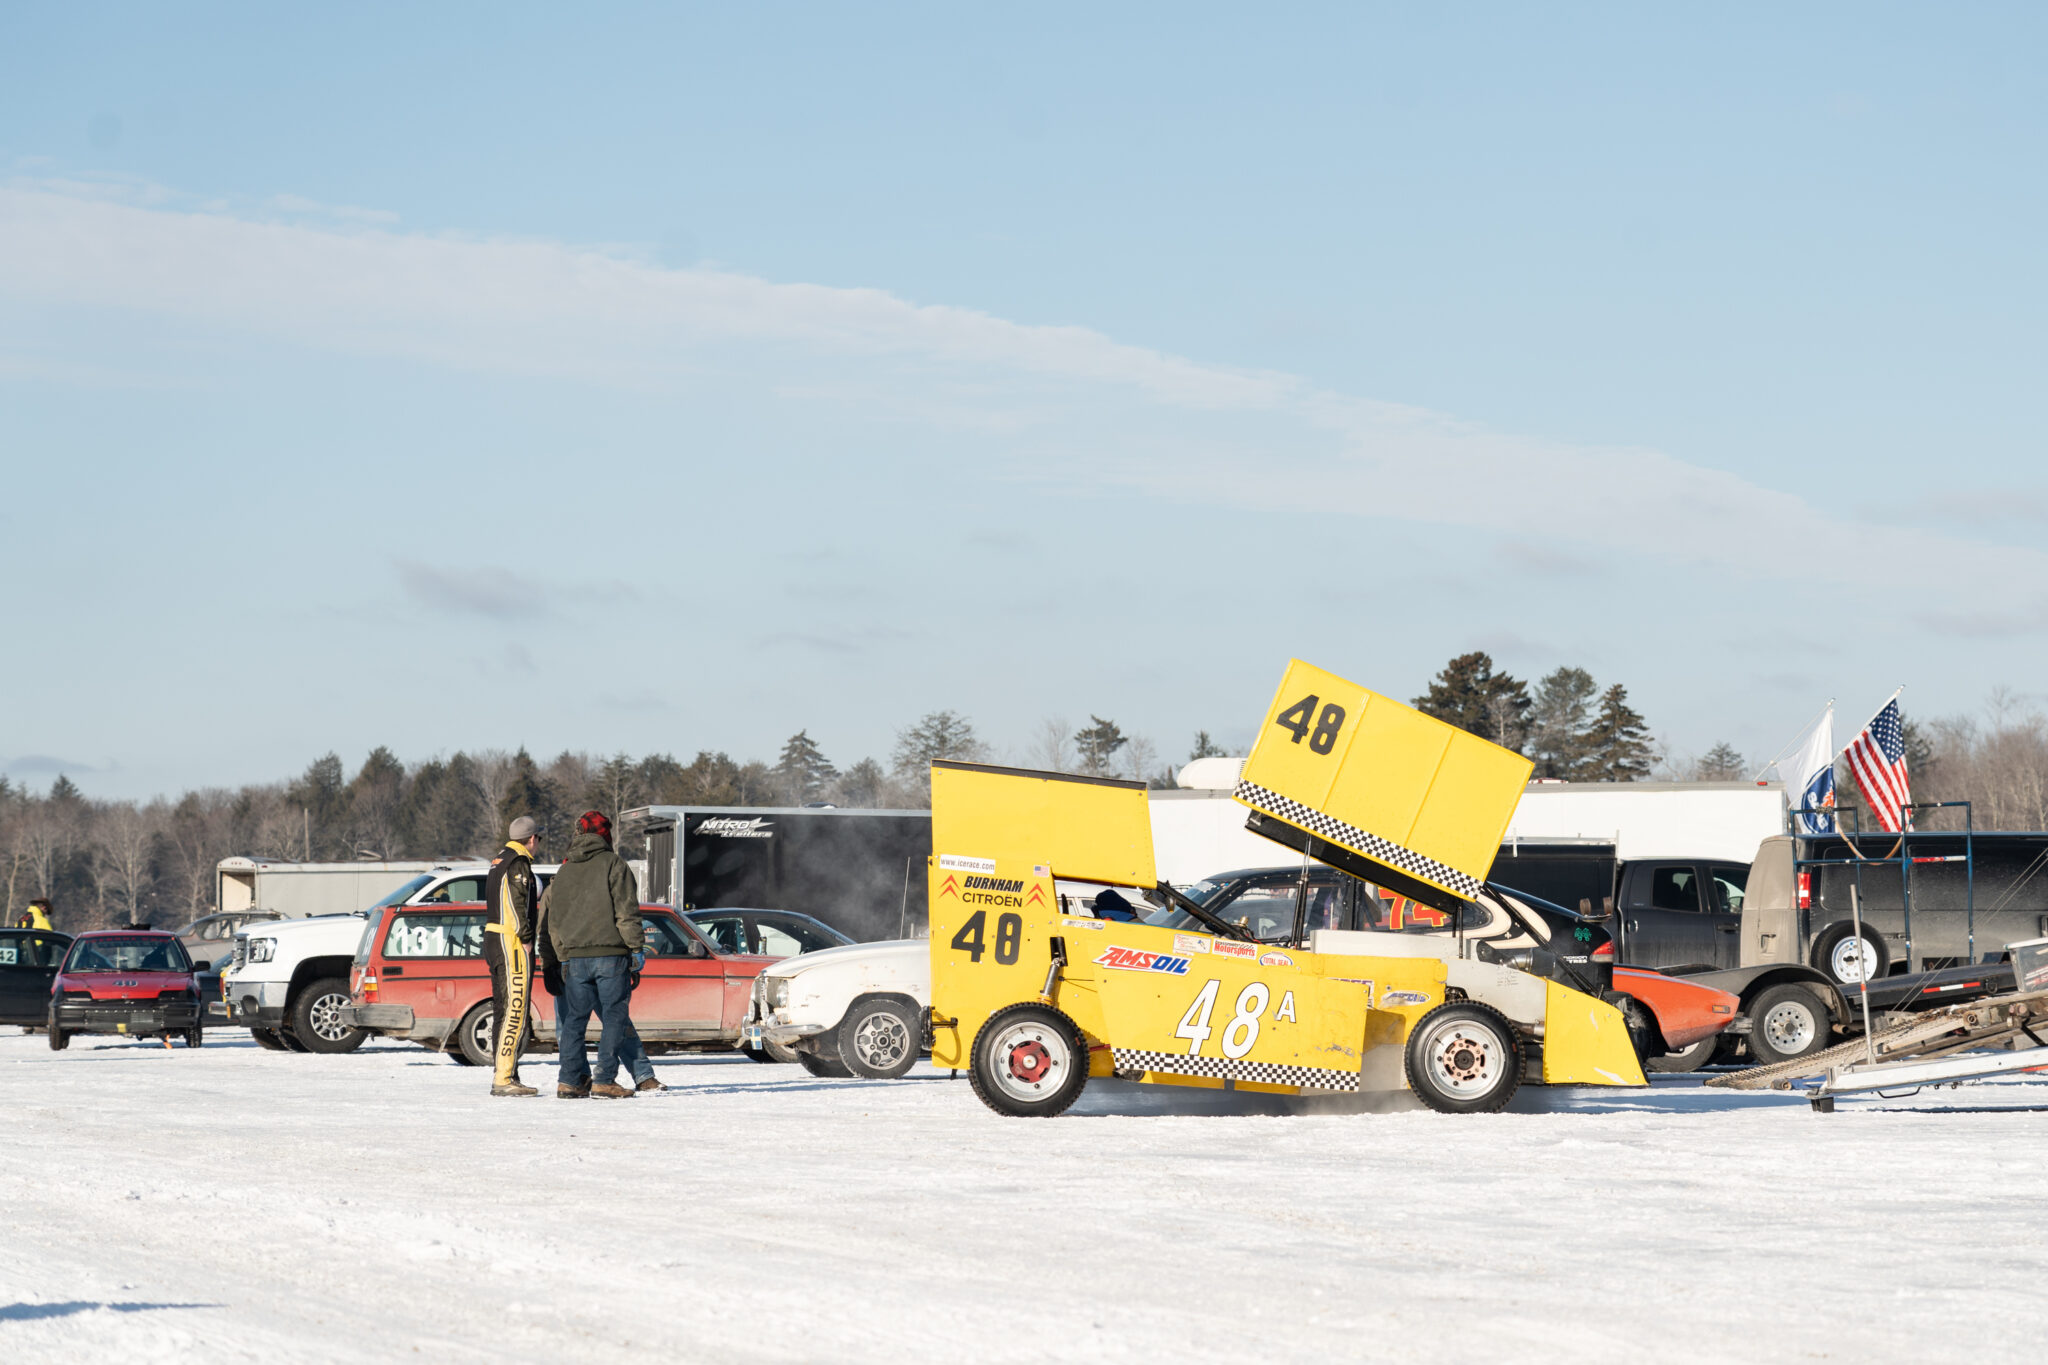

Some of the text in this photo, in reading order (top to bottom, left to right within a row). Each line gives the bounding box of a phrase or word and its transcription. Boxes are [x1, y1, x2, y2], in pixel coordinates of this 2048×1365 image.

[1275, 694, 1346, 756] 48
[699, 820, 751, 829] NITRO
[940, 858, 995, 871] www.icerace.com
[964, 875, 1024, 893] BURNHAM
[962, 892, 1023, 908] CITROËN
[395, 925, 445, 956] 131
[951, 910, 1023, 966] 48
[1099, 946, 1188, 973] AMSOIL
[1214, 943, 1256, 957] Motorsports
[1174, 979, 1297, 1060] 48 A
